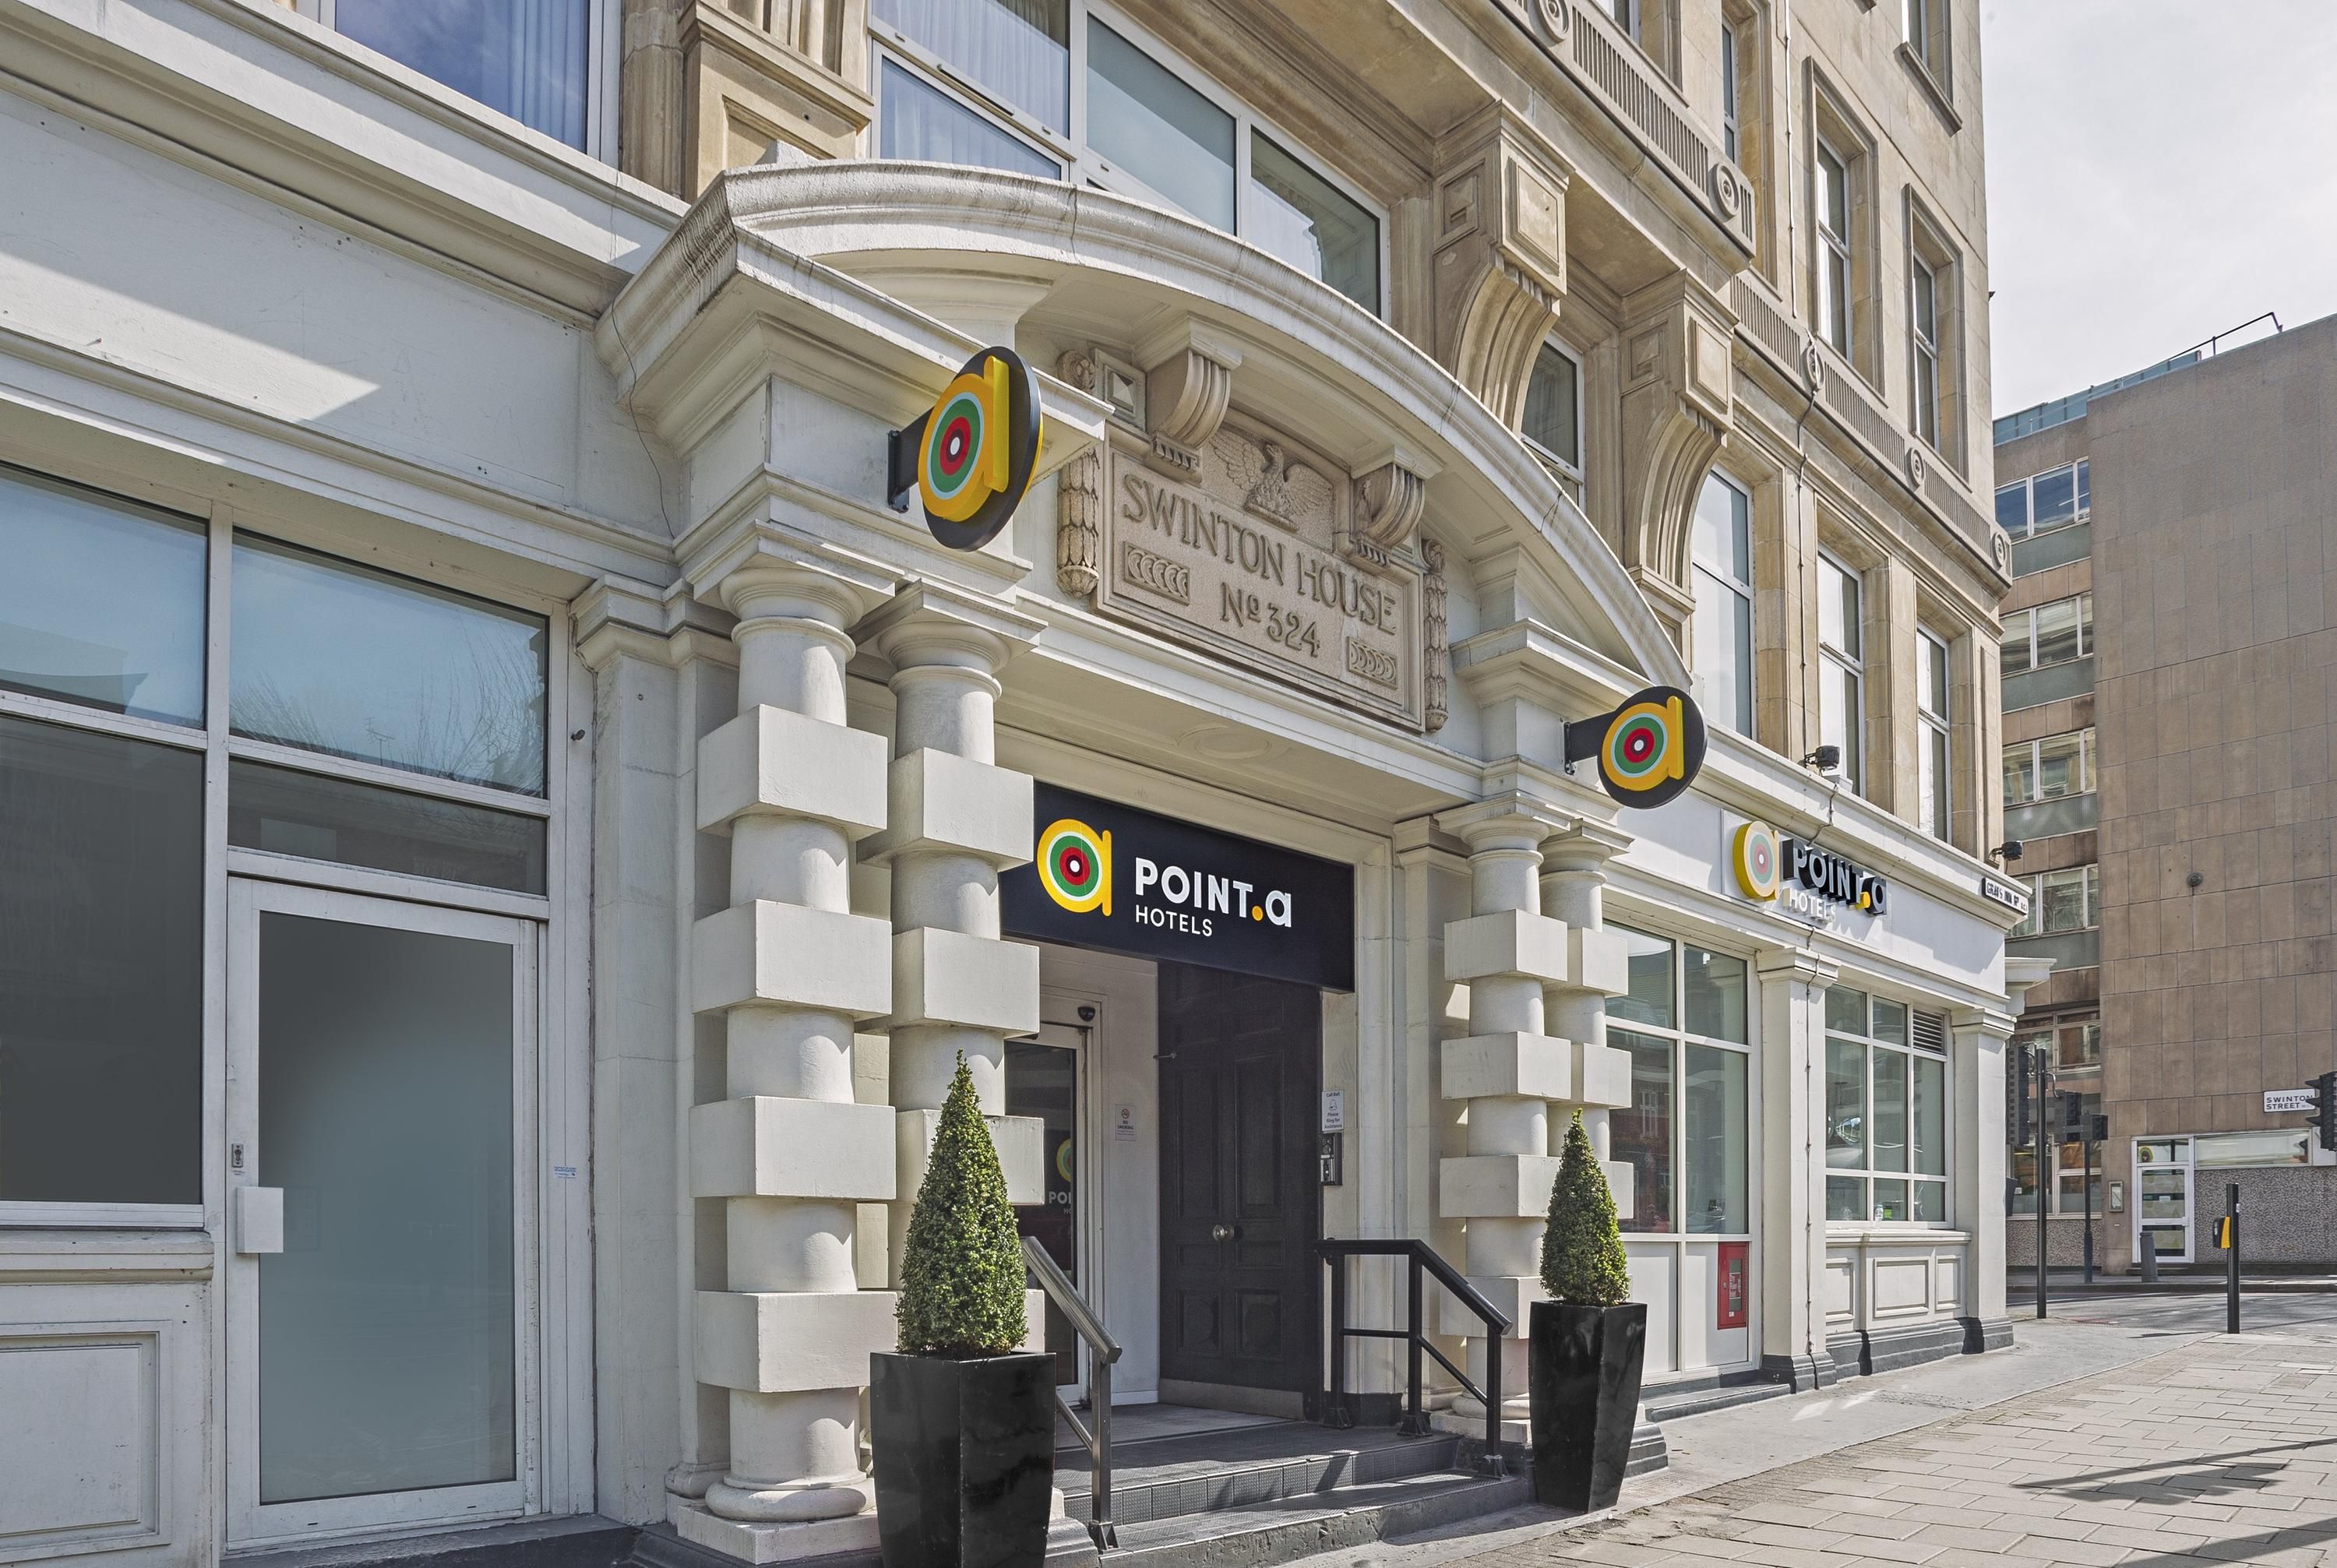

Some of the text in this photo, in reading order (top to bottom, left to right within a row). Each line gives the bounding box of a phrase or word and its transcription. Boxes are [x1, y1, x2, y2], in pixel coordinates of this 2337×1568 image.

[1123, 474, 1397, 636] SWINTON HOUSE
[1267, 602, 1322, 659] 324
[1135, 904, 1213, 937] HOTELS
[1785, 887, 1836, 923] HOTELS
